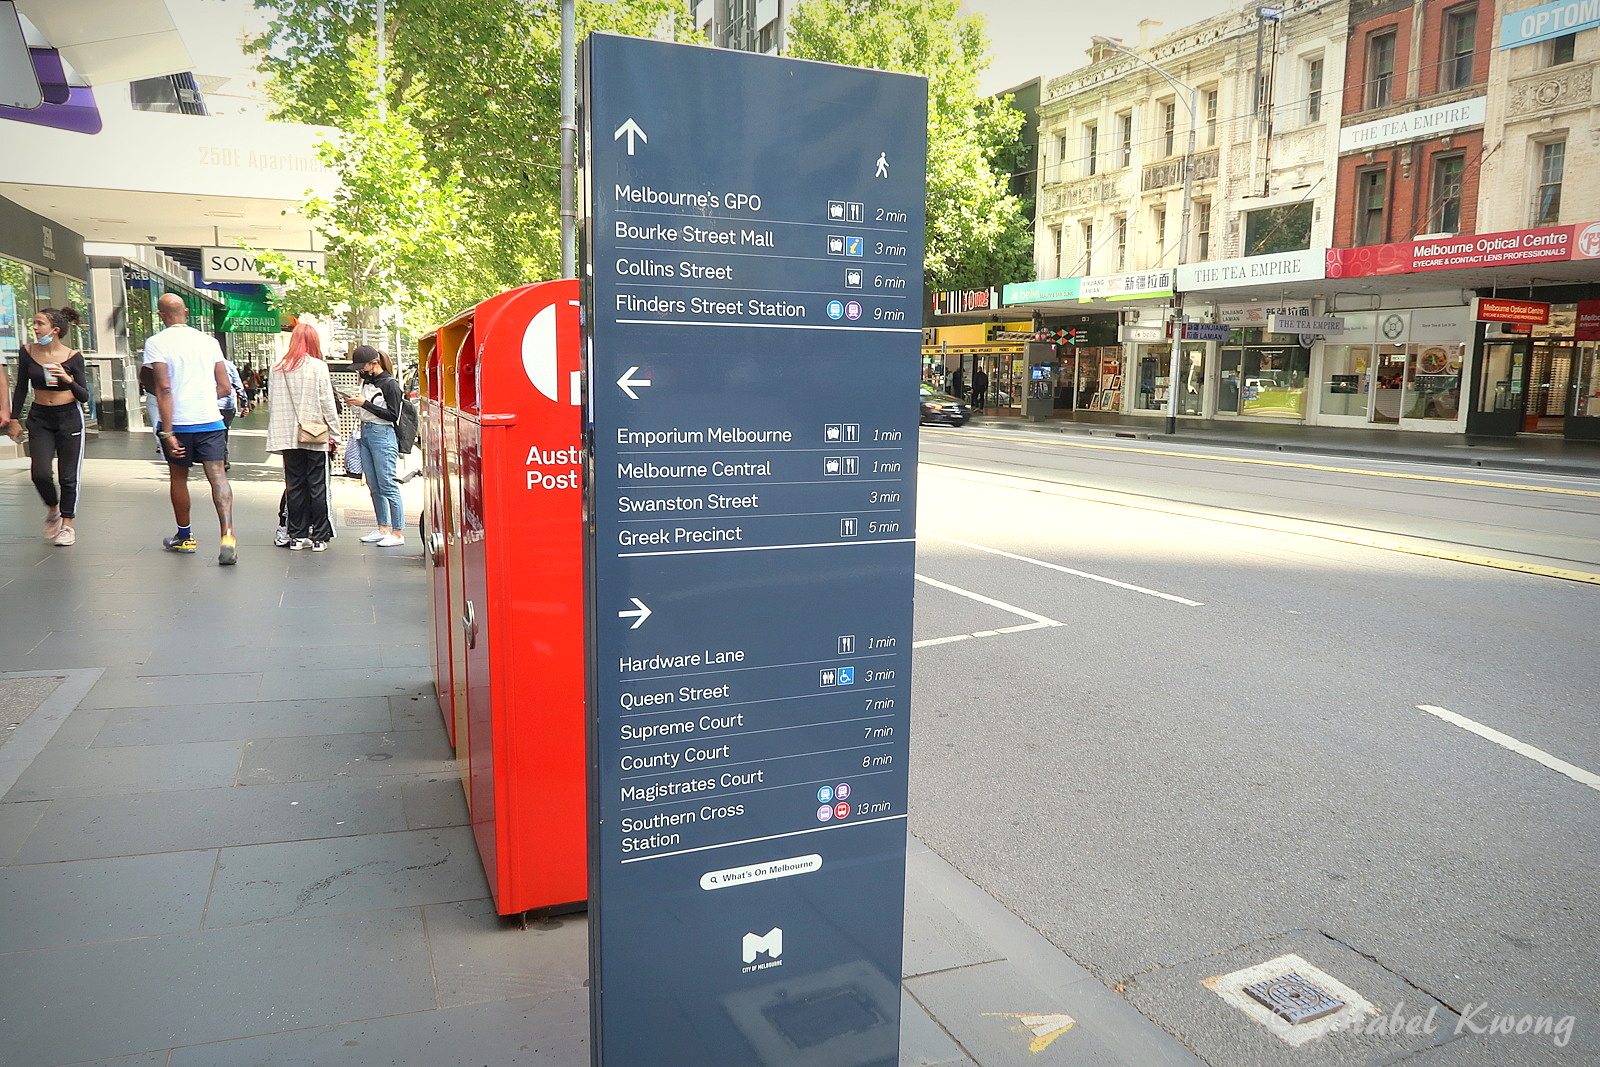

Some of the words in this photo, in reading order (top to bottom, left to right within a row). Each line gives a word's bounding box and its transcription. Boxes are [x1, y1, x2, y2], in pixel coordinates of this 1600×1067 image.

[1520, 0, 1600, 38] OPTOM
[1352, 127, 1378, 143] THE
[1382, 121, 1408, 137] TEA
[1413, 106, 1470, 131] EMPIRE
[248, 150, 335, 174] Apartmen
[614, 183, 720, 208] Melbourne's
[724, 192, 762, 211] GPO
[875, 207, 885, 221] 2
[885, 211, 907, 223] min
[615, 221, 678, 242] Bourke
[682, 225, 737, 245] Street
[740, 229, 775, 248] Mall
[874, 241, 884, 255] 3
[885, 245, 907, 257] min
[1413, 244, 1474, 259] Melbourne
[1476, 236, 1519, 254] Optical
[1522, 231, 1568, 248] Centre
[211, 256, 317, 272] SOMET
[1412, 258, 1444, 268] EYECARE
[1444, 257, 1450, 266] &
[1450, 254, 1483, 265] CONTACT
[1483, 252, 1503, 262] LENS
[1503, 246, 1567, 260] PROFESSIONALS
[615, 258, 675, 278] Collins
[679, 261, 733, 281] Street
[1195, 268, 1219, 283] THE
[1221, 265, 1247, 280] TEA
[1251, 258, 1302, 277] EMPIRE
[874, 274, 883, 288] 6
[884, 278, 906, 289] min
[616, 294, 686, 313] Flinders
[690, 297, 744, 315] Street
[748, 299, 806, 317] Station
[873, 307, 882, 320] 9
[883, 308, 905, 321] min
[1484, 304, 1510, 312] Melbourne
[1510, 305, 1527, 314] Optical
[245, 317, 276, 327] STRAND
[1200, 324, 1228, 332] XINJIANG
[1280, 320, 1294, 328] THE
[1312, 322, 1340, 330] EMPIRE
[617, 427, 704, 448] Emporium
[707, 427, 792, 443] Melbourne
[873, 429, 879, 441] 1
[880, 431, 902, 441] min
[617, 462, 708, 479] Melbourne
[711, 460, 772, 477] Central
[872, 460, 878, 473] 1
[880, 462, 901, 473] min
[527, 470, 578, 490] Post
[618, 496, 703, 513] Swanston
[707, 493, 759, 510] Street
[869, 491, 878, 504] 3
[879, 493, 900, 503] min
[618, 528, 670, 546] Greek
[674, 526, 743, 543] Precinct
[868, 521, 878, 534] 5
[878, 522, 900, 533] min
[868, 637, 874, 649] 1
[875, 637, 896, 648] min
[619, 654, 701, 673] Hardware
[705, 649, 745, 665] Lane
[864, 670, 874, 682] 3
[874, 670, 895, 681] min
[620, 691, 675, 710] Queen
[678, 684, 730, 702] Street
[865, 699, 873, 711] 7
[873, 699, 895, 710] min
[620, 721, 695, 741] Supreme
[699, 713, 744, 731] Court
[864, 727, 872, 739] 7
[873, 727, 894, 738] min
[620, 751, 680, 769] County
[684, 744, 730, 763] Court
[862, 755, 871, 768] 8
[872, 753, 893, 767] min
[620, 778, 716, 802] Magistrates
[719, 769, 764, 787] Court
[621, 810, 696, 833] Southern
[700, 804, 745, 821] Cross
[856, 802, 870, 816] 13
[870, 801, 891, 813] min
[621, 832, 680, 853] Station
[722, 869, 752, 882] What's
[754, 868, 767, 877] On
[769, 860, 813, 875] Melbourne
